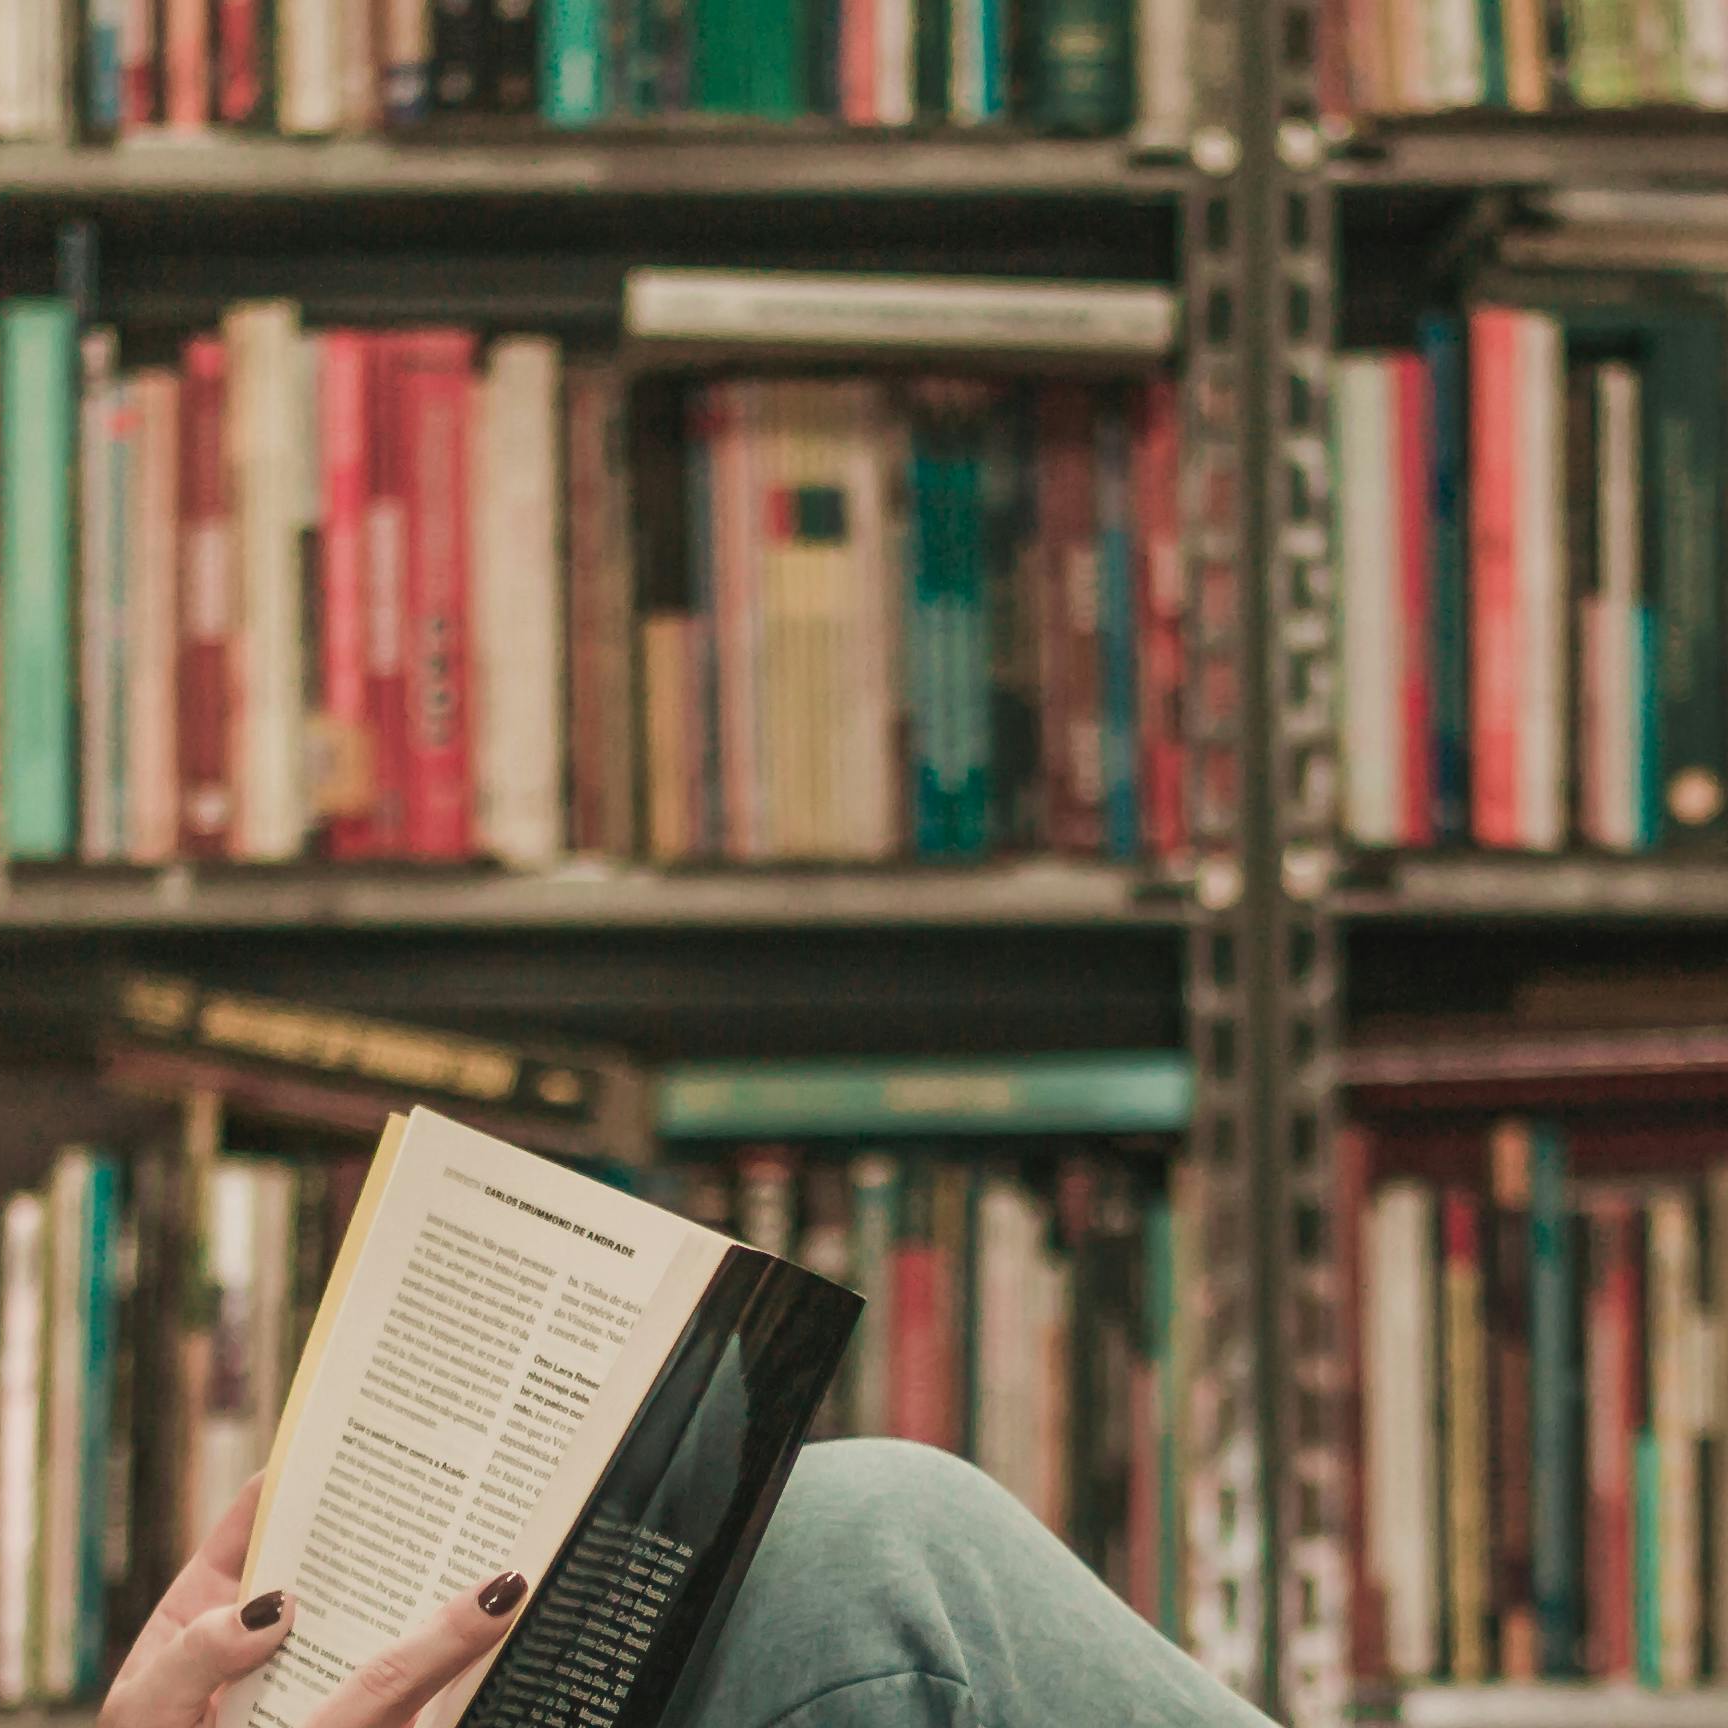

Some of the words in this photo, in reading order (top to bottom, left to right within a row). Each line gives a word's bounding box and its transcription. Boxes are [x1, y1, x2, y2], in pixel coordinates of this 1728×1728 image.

[484, 1186, 518, 1206] CARLOS
[518, 1201, 572, 1230] DRUMMOND
[572, 1224, 586, 1236] DE
[586, 1232, 634, 1258] ANDRADE
[583, 1282, 608, 1302] Tinha
[608, 1295, 622, 1306] de
[616, 1316, 628, 1328] de
[534, 1354, 552, 1370] Otto
[552, 1363, 574, 1378] Lara
[506, 1493, 536, 1510] doçur
